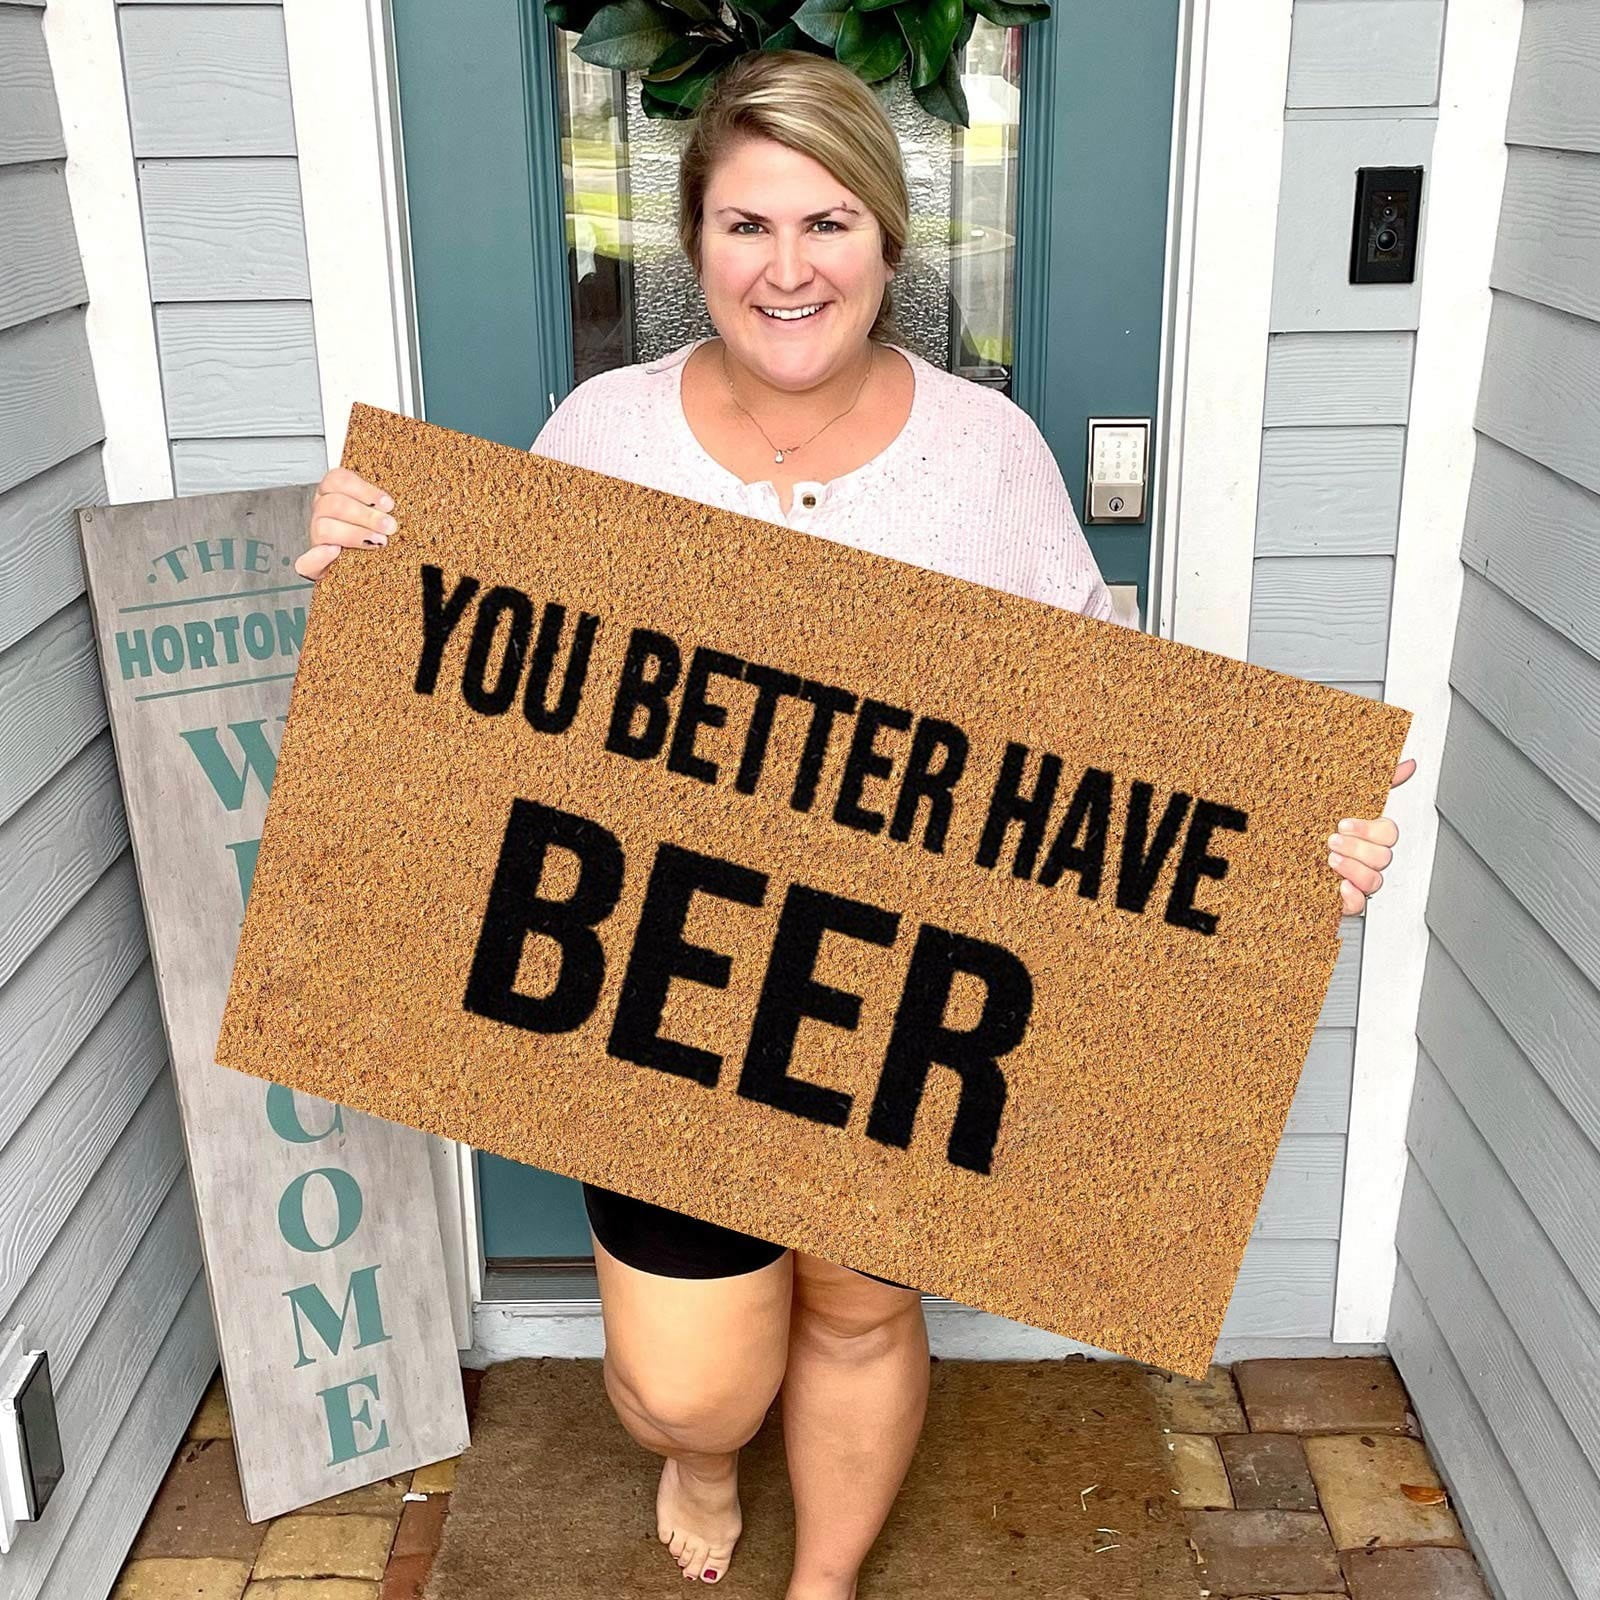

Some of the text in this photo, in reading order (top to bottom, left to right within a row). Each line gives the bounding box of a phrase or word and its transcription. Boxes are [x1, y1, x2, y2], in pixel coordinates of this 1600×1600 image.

[151, 537, 275, 584] THE
[414, 564, 1249, 936] YOU BETTER HAVE
[463, 798, 1035, 1176] BEER
